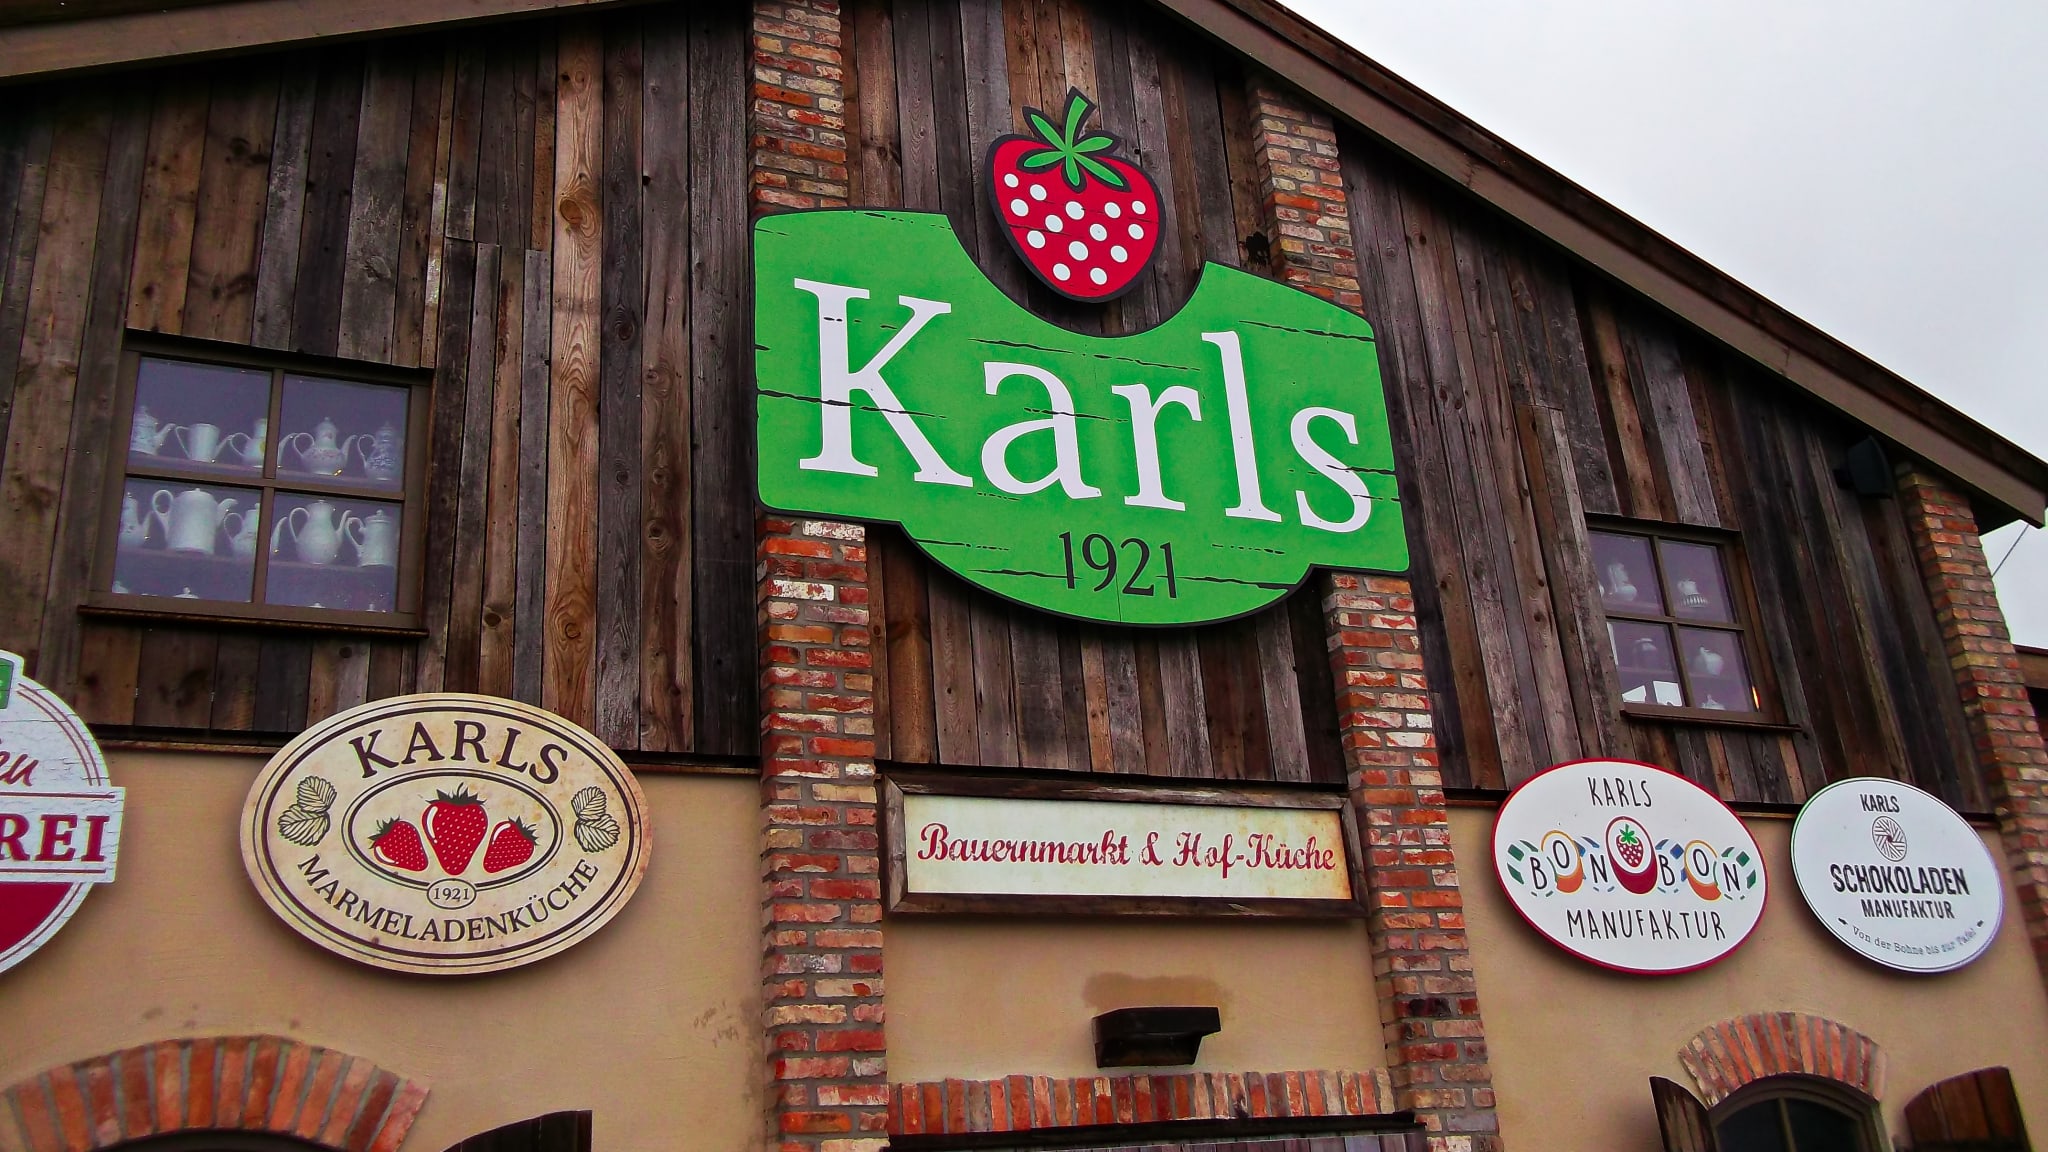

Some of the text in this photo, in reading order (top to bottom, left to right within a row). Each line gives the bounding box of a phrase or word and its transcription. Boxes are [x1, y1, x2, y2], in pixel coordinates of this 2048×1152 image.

[794, 278, 1372, 534] Karls
[1057, 530, 1177, 599] 1921
[348, 719, 569, 784] KARLS
[1587, 776, 1652, 808] KARLS
[1859, 793, 1900, 814] KARLS
[917, 822, 1336, 880] Bauernmarkt & Hof-Küche
[433, 887, 472, 903] 1921
[1830, 863, 1970, 896] SCHOKOLADEN
[297, 853, 599, 943] MARMELADENKÜCHE
[1860, 898, 1955, 919] MANUFAKTUR
[1566, 908, 1726, 941] MANUFAKTUR
[1852, 925, 1871, 943] Von
[1874, 936, 1892, 950] der
